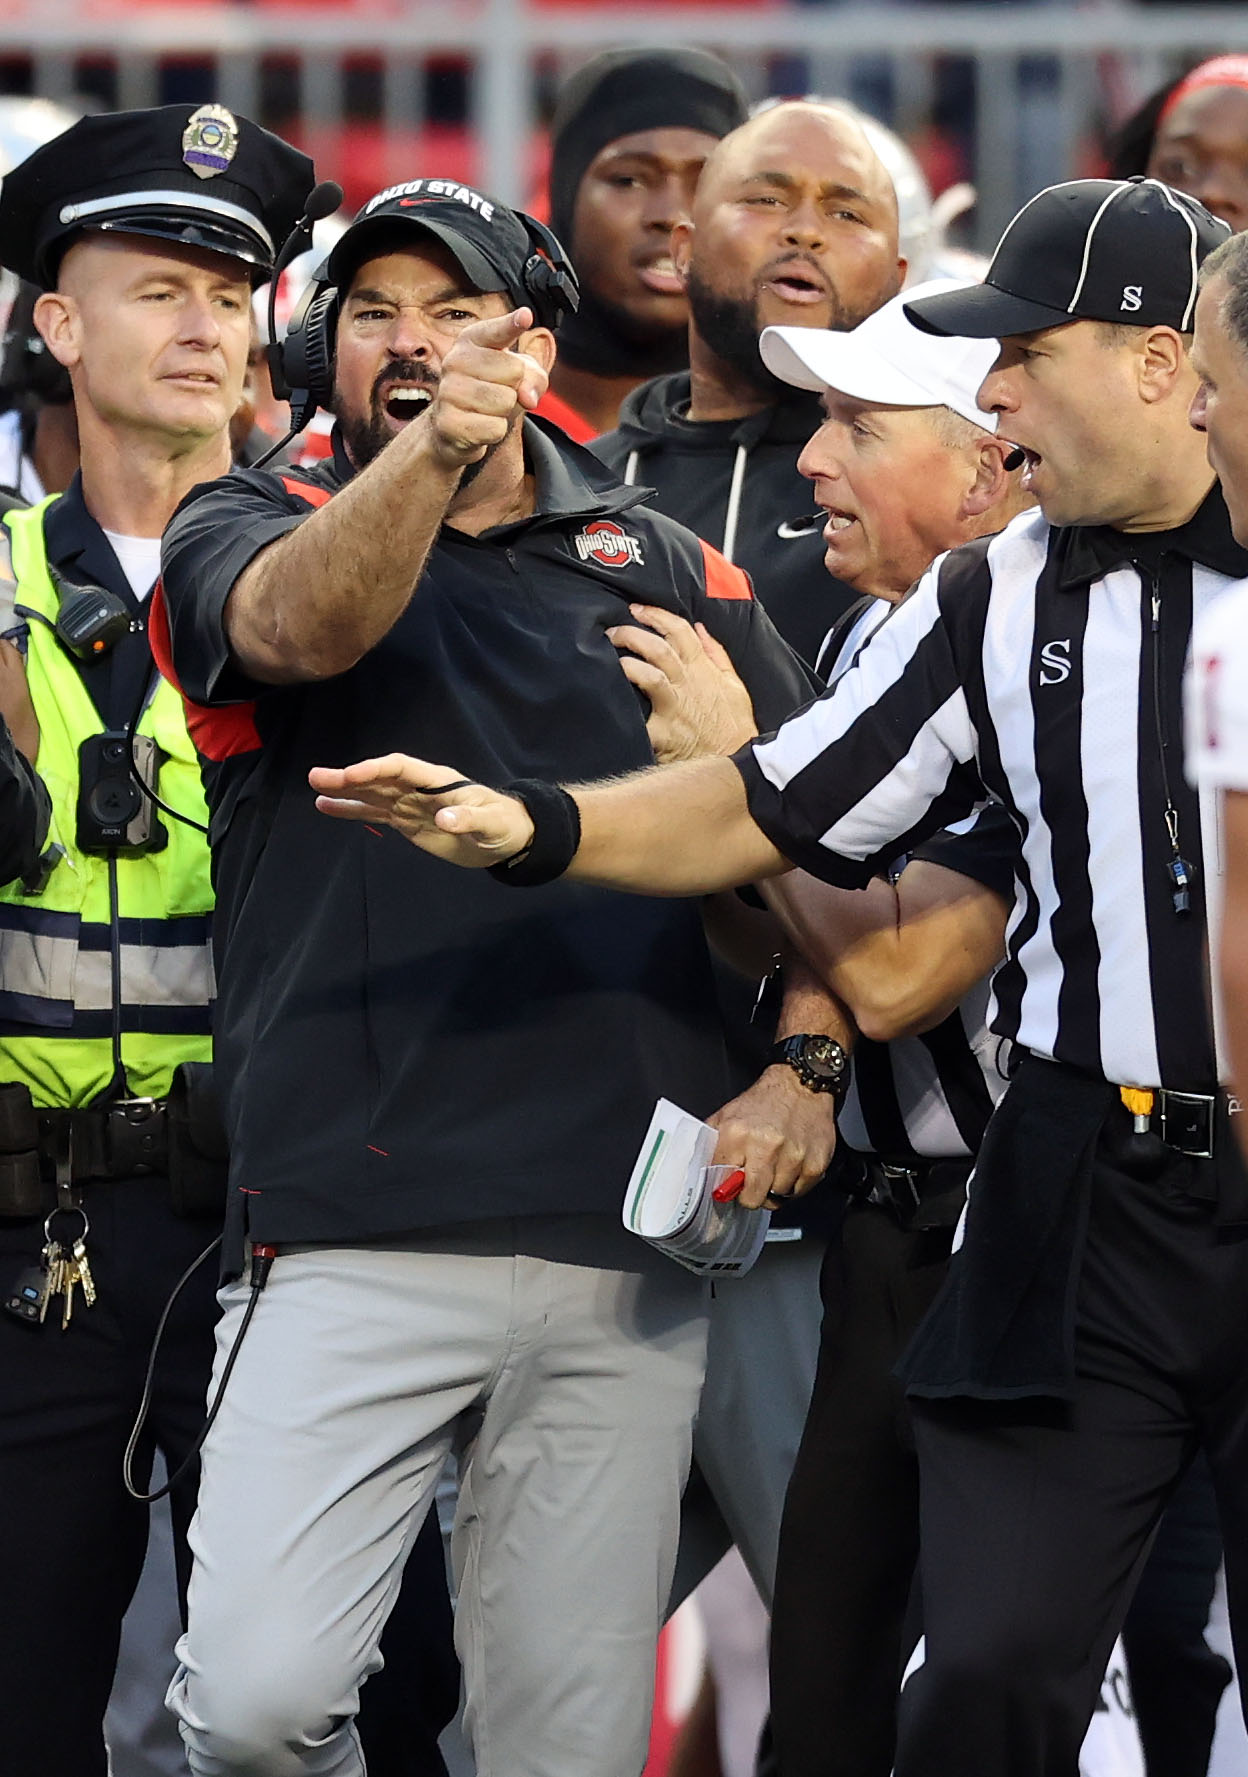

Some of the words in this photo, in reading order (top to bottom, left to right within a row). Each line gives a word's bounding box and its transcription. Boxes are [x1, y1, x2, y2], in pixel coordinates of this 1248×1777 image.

[365, 179, 423, 215] OHIO
[427, 180, 495, 222] STATE
[1120, 285, 1143, 311] S
[1039, 639, 1072, 686] S
